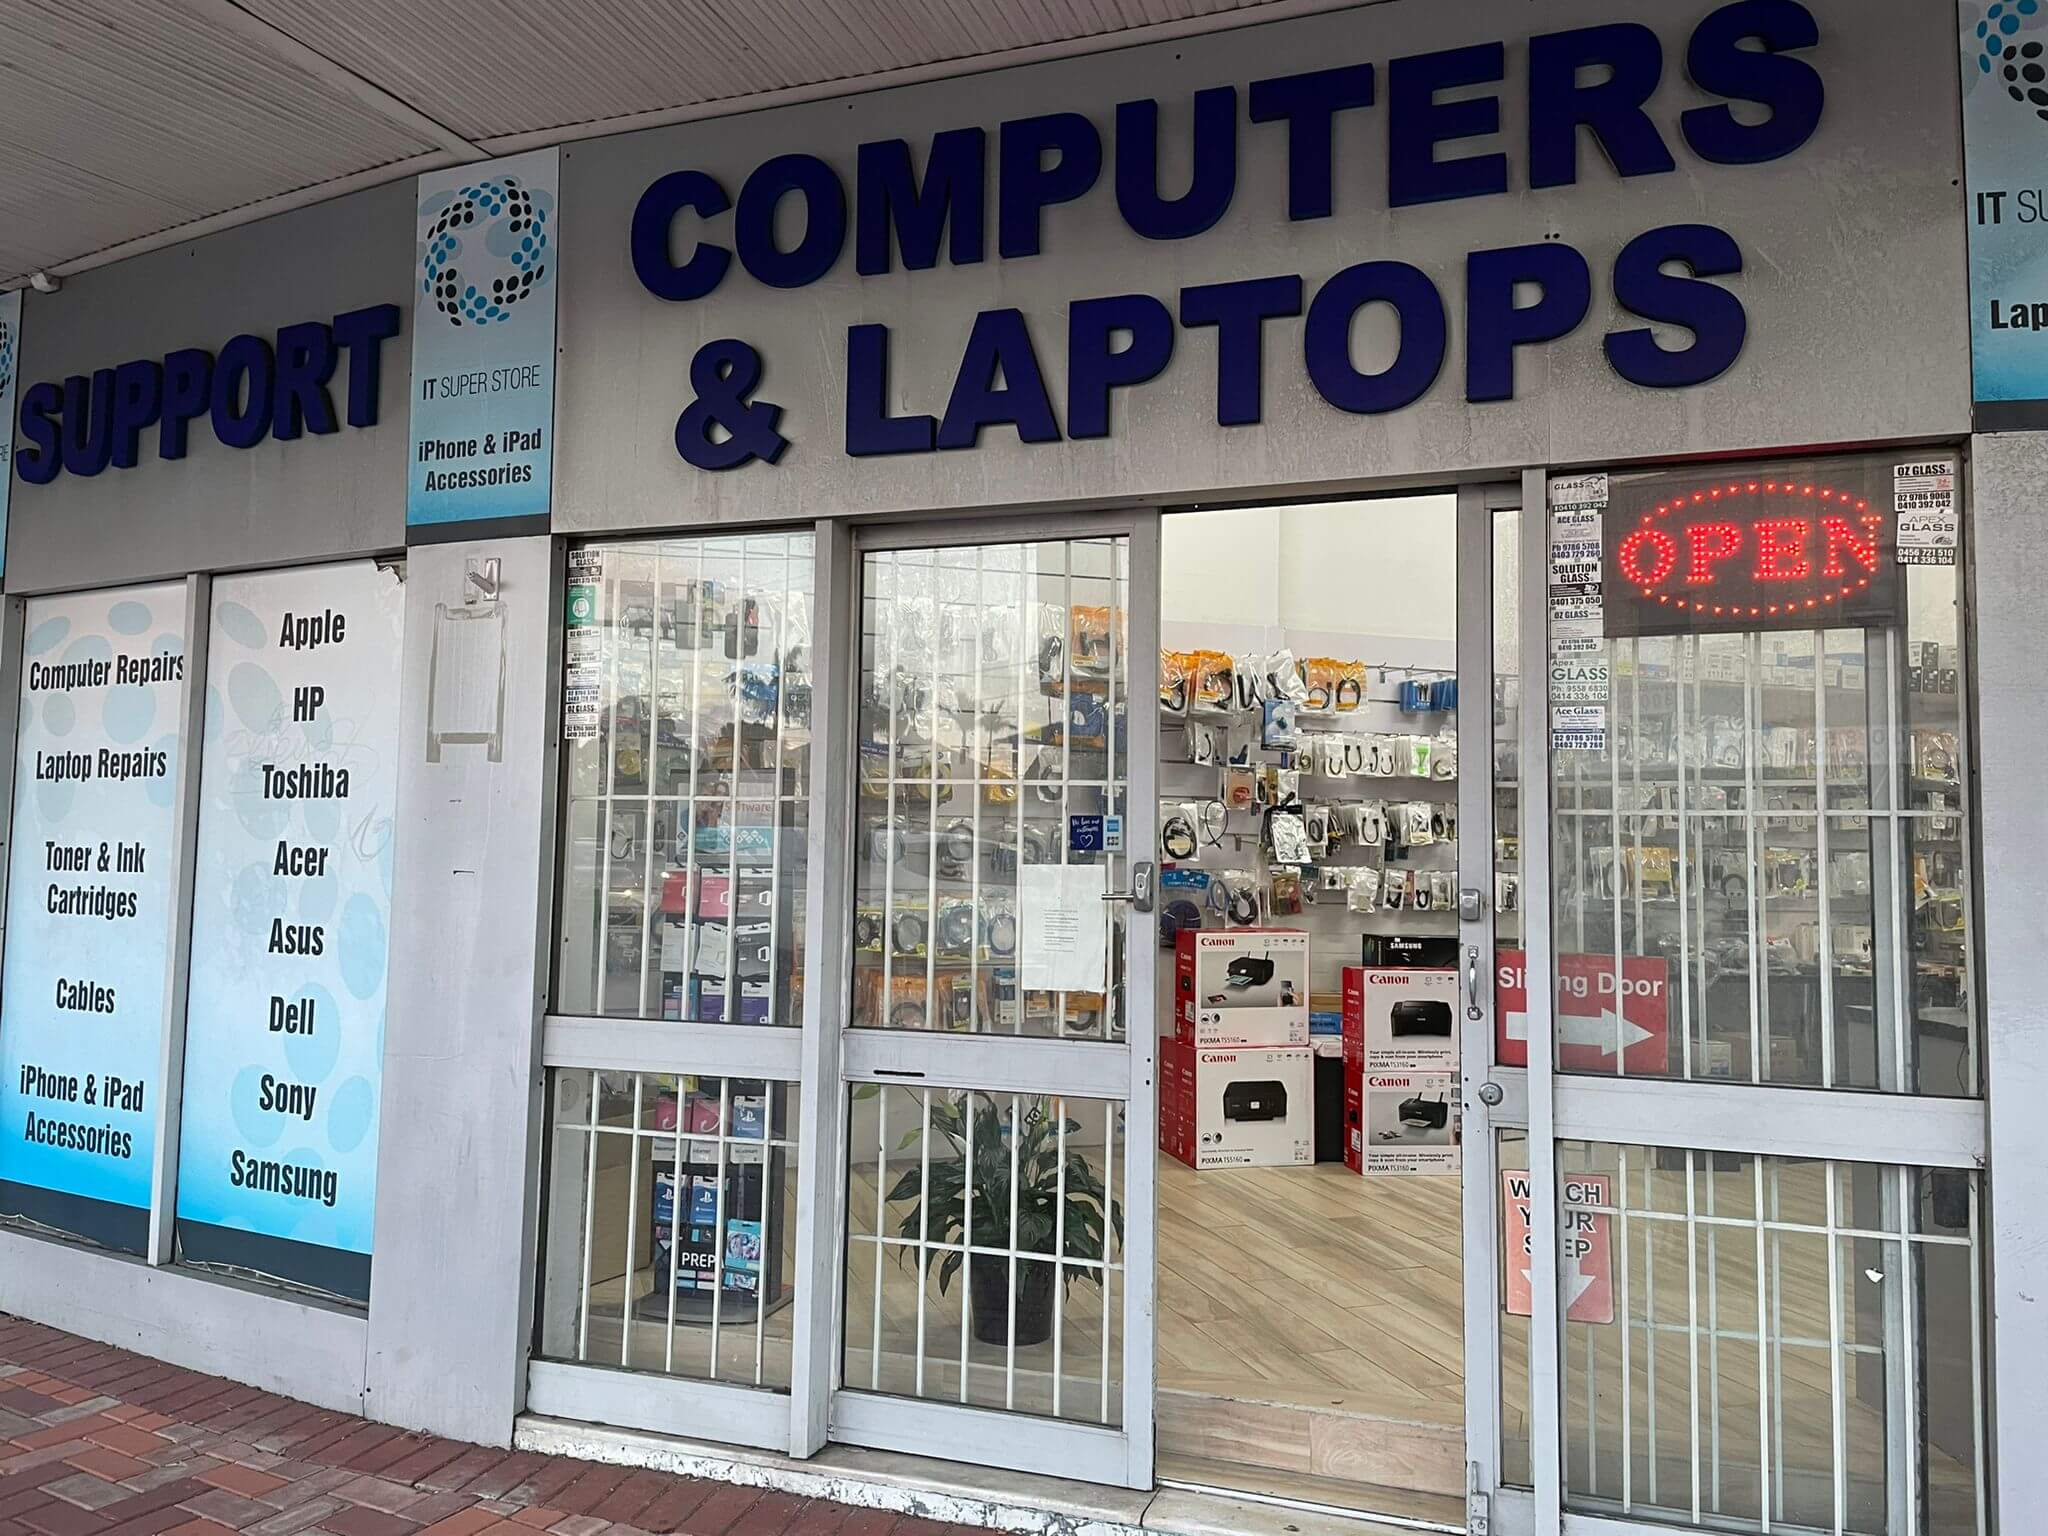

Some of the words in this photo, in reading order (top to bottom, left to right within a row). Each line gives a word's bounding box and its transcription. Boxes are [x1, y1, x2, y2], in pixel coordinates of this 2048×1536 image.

[631, 0, 1824, 301] COMPUTERS
[1977, 191, 2006, 225] IT
[1991, 300, 2048, 332] Lap
[675, 338, 791, 471] &
[846, 223, 1746, 457] LAPTOPS
[15, 303, 400, 484] SUPPORT
[423, 378, 437, 400] IT
[441, 372, 487, 398] SUPER
[492, 365, 540, 391] STORE
[418, 439, 477, 462] iPhone
[483, 434, 497, 454] &
[503, 428, 542, 453] iPad
[425, 463, 532, 492] Accessories
[1898, 466, 1910, 476] OZ
[1912, 464, 1946, 475] GLASS
[1557, 516, 1571, 524] ACE
[1900, 523, 1955, 532] GLASS
[1619, 515, 1882, 585] OPEN
[1552, 563, 1598, 575] SOLUTION
[1560, 573, 1590, 583] GLASS
[279, 609, 346, 651] Apple
[1565, 610, 1589, 619] GLASS
[30, 659, 112, 691] Computer
[117, 651, 184, 687] Repairs
[1552, 668, 1608, 681] GLASS
[293, 686, 324, 722] HP
[1555, 707, 1572, 715] Ace
[1573, 706, 1599, 715] Glass
[36, 750, 91, 783] Laptop
[98, 747, 167, 781] Repairs
[262, 763, 349, 799] Toshiba
[46, 841, 91, 873] Toner
[97, 842, 110, 872] &
[117, 842, 145, 873] Ink
[273, 840, 328, 876] Acer
[47, 884, 137, 920] Cartridges
[268, 918, 324, 956] Asus
[1201, 937, 1235, 947] Canon
[1390, 942, 1422, 950] SAMSUNG
[55, 977, 115, 1014] Cables
[1369, 974, 1409, 985] Canon
[1499, 967, 1588, 998] Slng
[1598, 972, 1663, 997] Door
[269, 996, 314, 1036] Dell
[1201, 1054, 1237, 1064] Canon
[20, 1064, 78, 1102] iPhone
[86, 1074, 97, 1102] &
[104, 1076, 144, 1113] iPad
[259, 1074, 316, 1121] Sony
[1369, 1076, 1410, 1087] Canon
[25, 1111, 132, 1159] Accessories
[230, 1149, 338, 1207] Samsung
[1510, 1179, 1601, 1204] WCH
